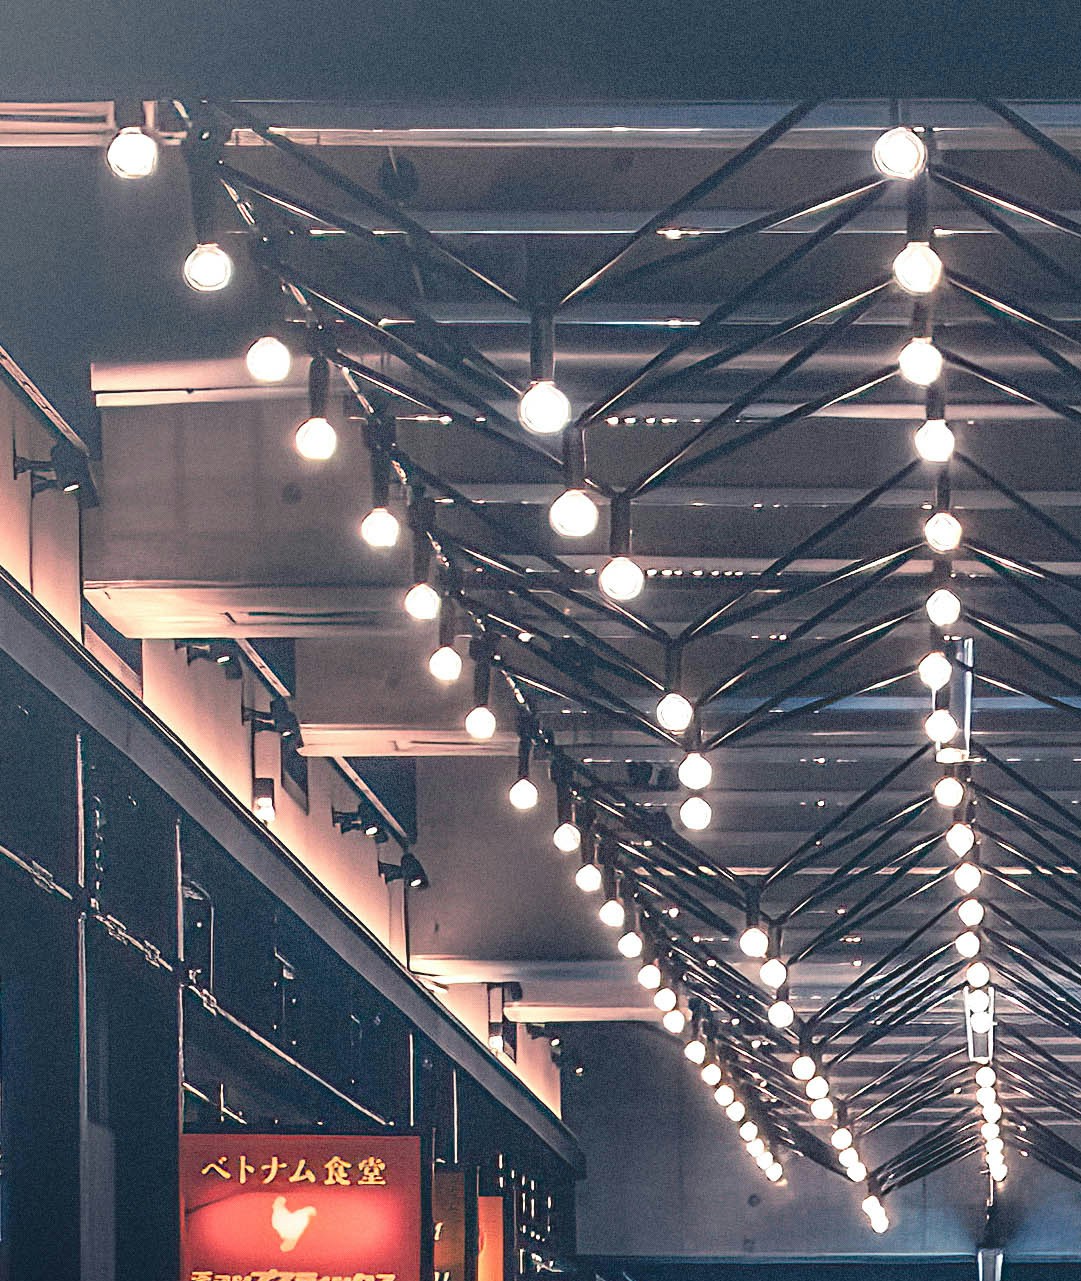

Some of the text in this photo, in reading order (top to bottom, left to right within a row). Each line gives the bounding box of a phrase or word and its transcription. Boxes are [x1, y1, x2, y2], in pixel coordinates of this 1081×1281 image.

[200, 1154, 387, 1187] ベトナム食堂
